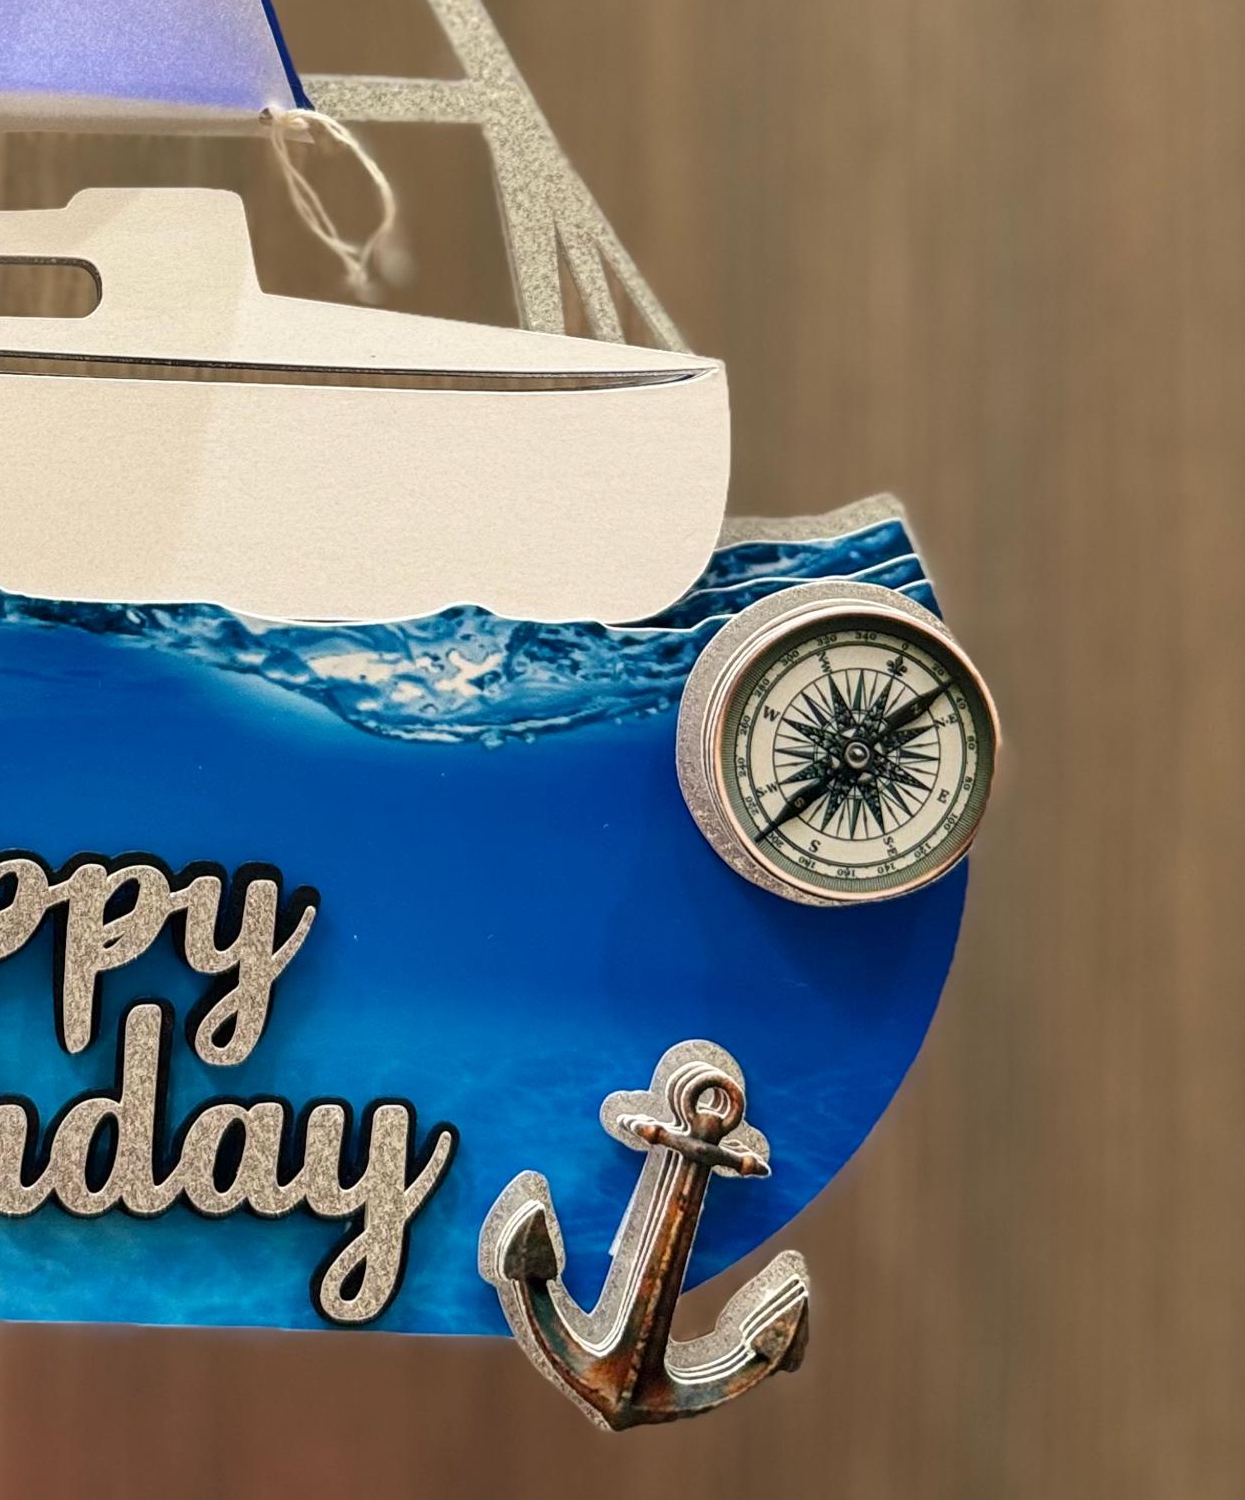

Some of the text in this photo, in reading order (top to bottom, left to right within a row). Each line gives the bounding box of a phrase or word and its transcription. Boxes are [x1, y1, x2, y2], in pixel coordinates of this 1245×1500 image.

[762, 705, 781, 722] W
[936, 788, 950, 804] E
[943, 813, 958, 831] 100
[808, 839, 822, 853] S
[914, 842, 932, 858] 120
[877, 863, 897, 874] 140
